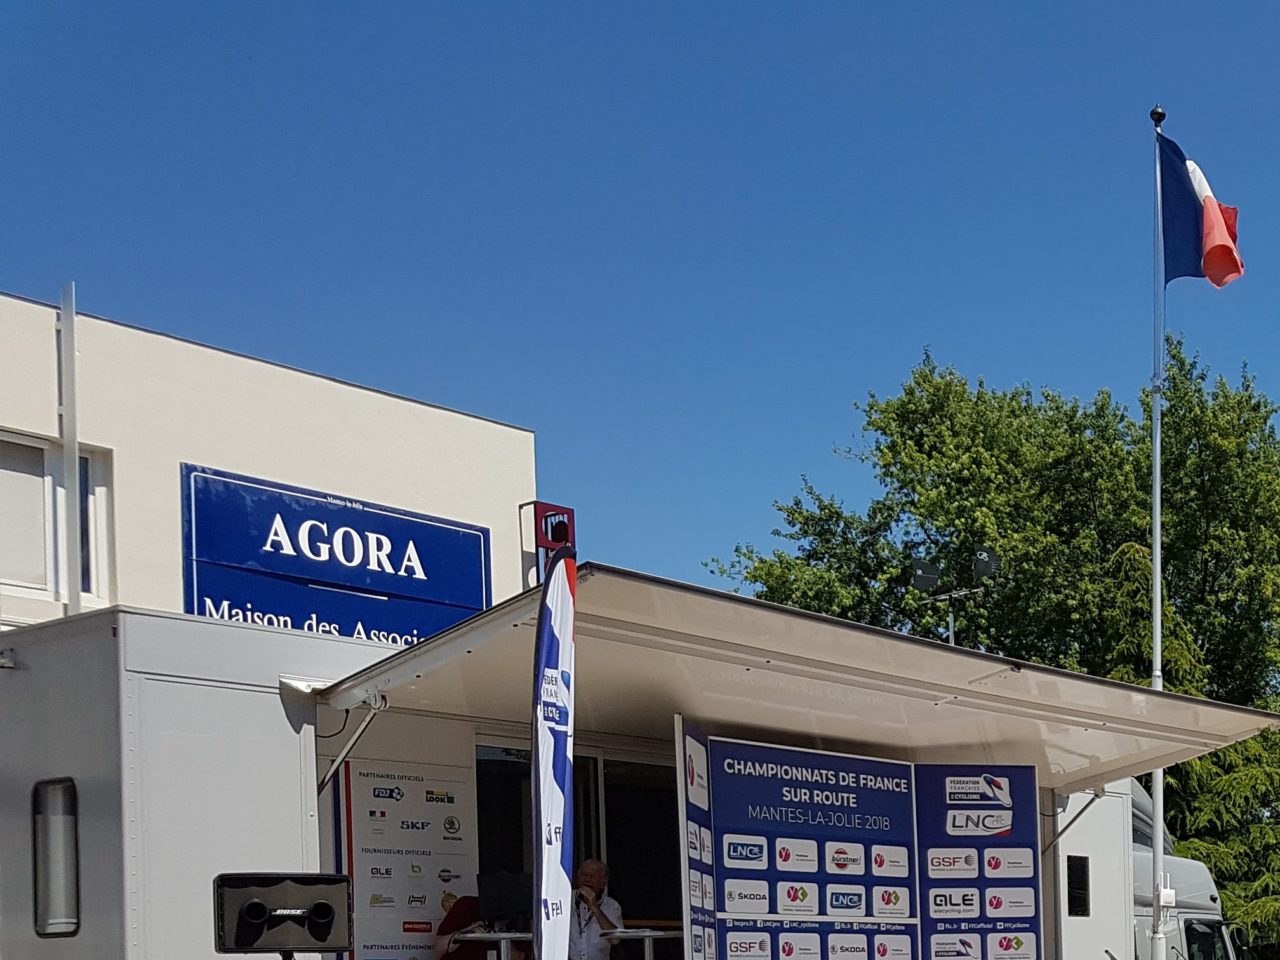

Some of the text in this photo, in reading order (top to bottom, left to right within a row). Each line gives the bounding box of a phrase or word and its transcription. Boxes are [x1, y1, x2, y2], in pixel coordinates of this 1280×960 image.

[262, 512, 427, 580] AGORA
[359, 772, 424, 782] PARTENAIRES OFFICIELS
[723, 758, 909, 792] CHAMPIONNATS DE FRANCE
[374, 788, 390, 797] FDJ
[782, 786, 857, 807] SUR ROUTE
[425, 795, 446, 803] LOOK
[748, 804, 891, 831] MANTES-LA-JOLIE 2018
[951, 813, 995, 830] LNC
[400, 820, 431, 830] SKF
[361, 847, 432, 856] FOURNISSEURS OFFICIELS
[930, 856, 963, 867] GSF
[737, 891, 767, 901] ŠKODA
[729, 941, 758, 953] GSF
[839, 944, 866, 953] ŠKODA
